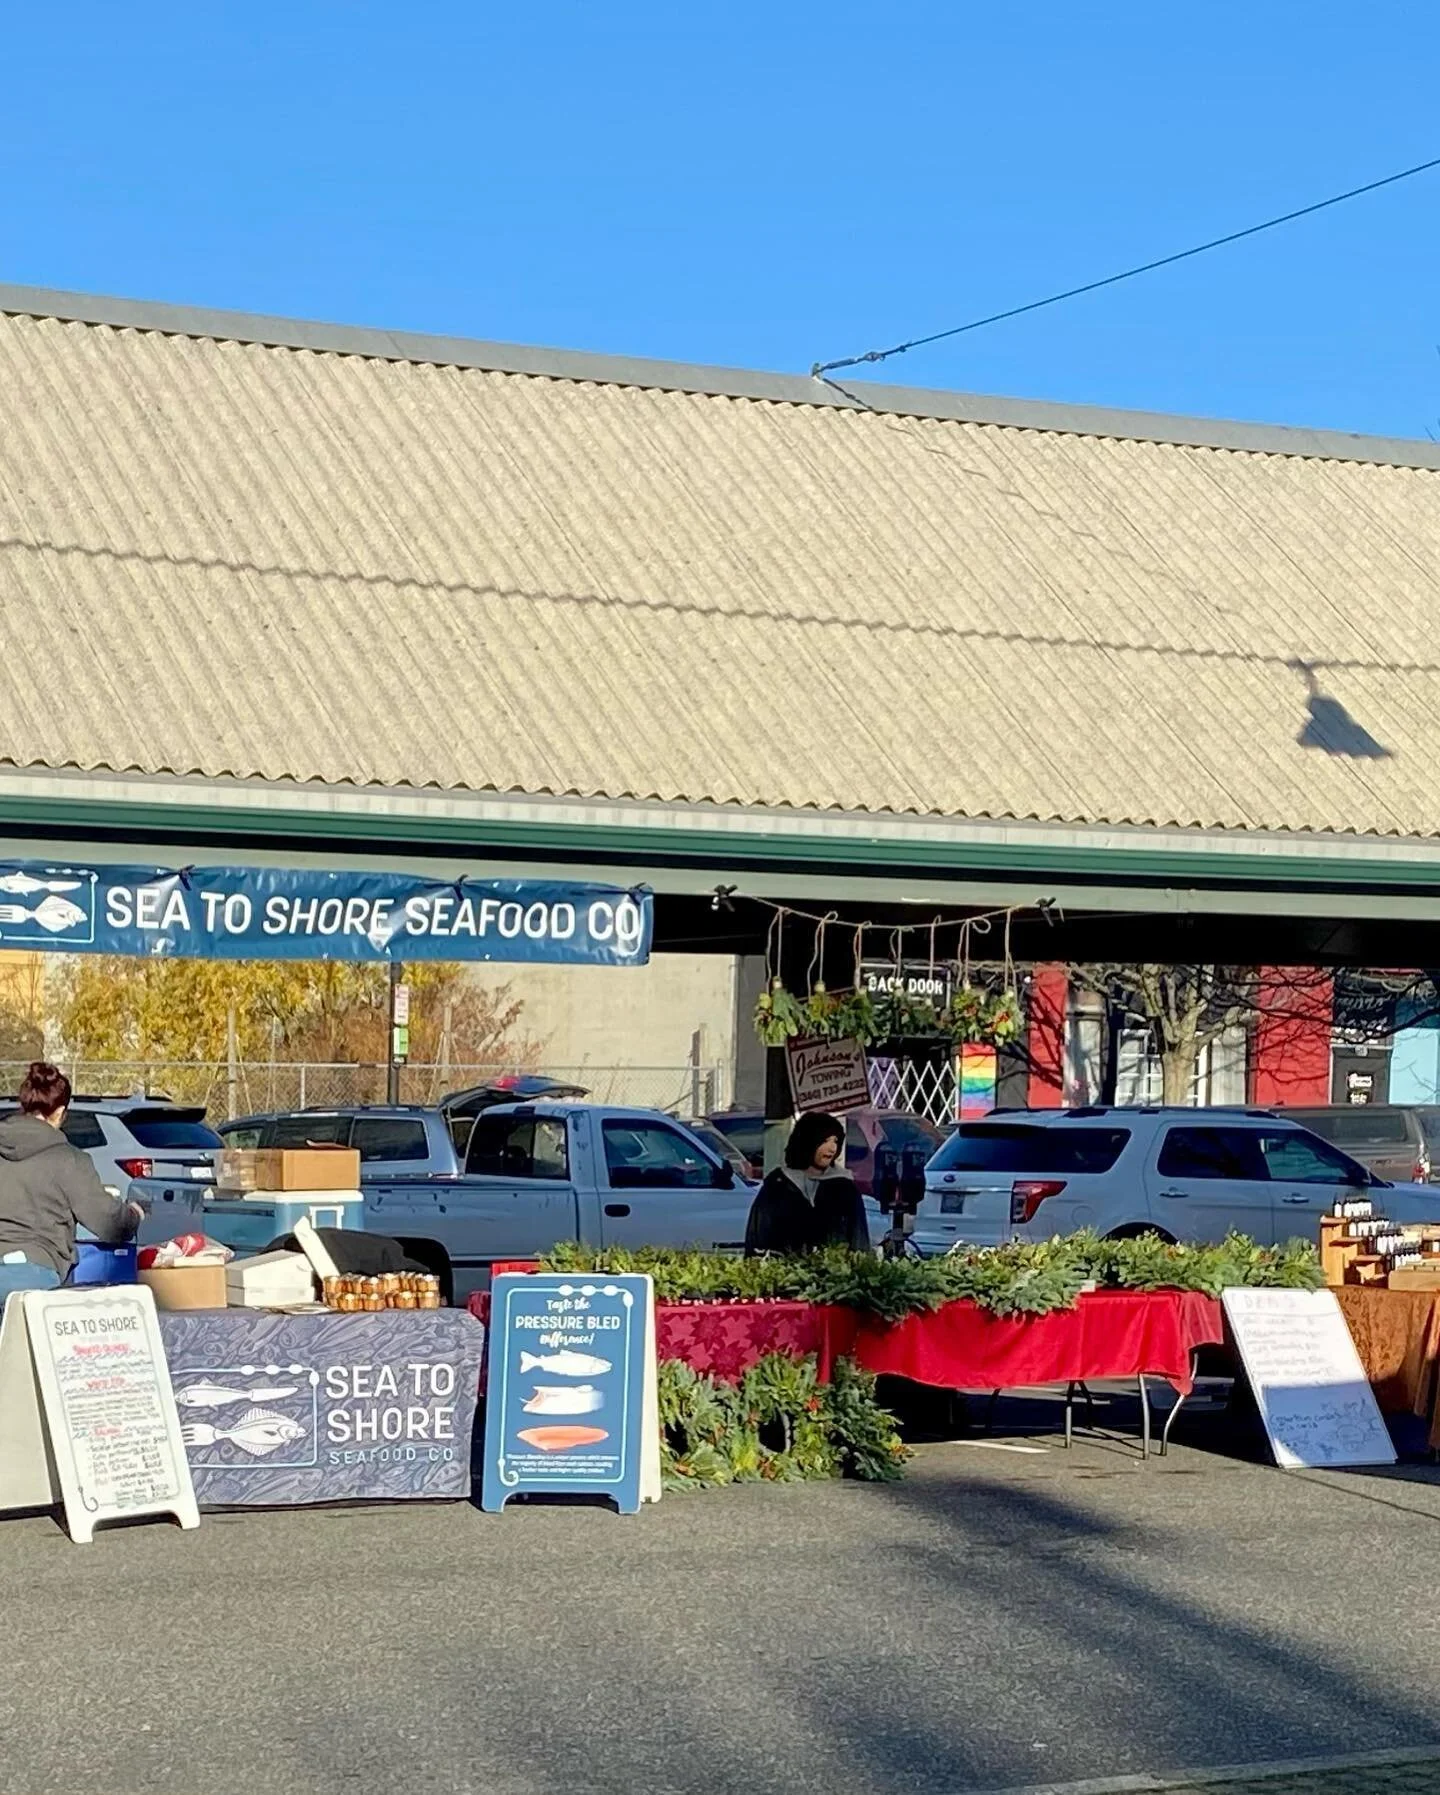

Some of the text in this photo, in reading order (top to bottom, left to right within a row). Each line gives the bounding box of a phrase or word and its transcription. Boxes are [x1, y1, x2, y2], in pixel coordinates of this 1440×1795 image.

[105, 885, 641, 942] SEA TO SHORE SEAFOOD CO
[868, 976, 943, 995] BACK DOOR
[810, 1069, 852, 1084] TOWING
[546, 1296, 591, 1313] Taste the
[55, 1316, 139, 1336] SEA TO SHORE
[515, 1315, 621, 1330] PRESSURE BLED
[325, 1363, 455, 1399] SEA TO
[327, 1406, 455, 1443] SHORE
[329, 1446, 454, 1466] SEAFOOD CO
